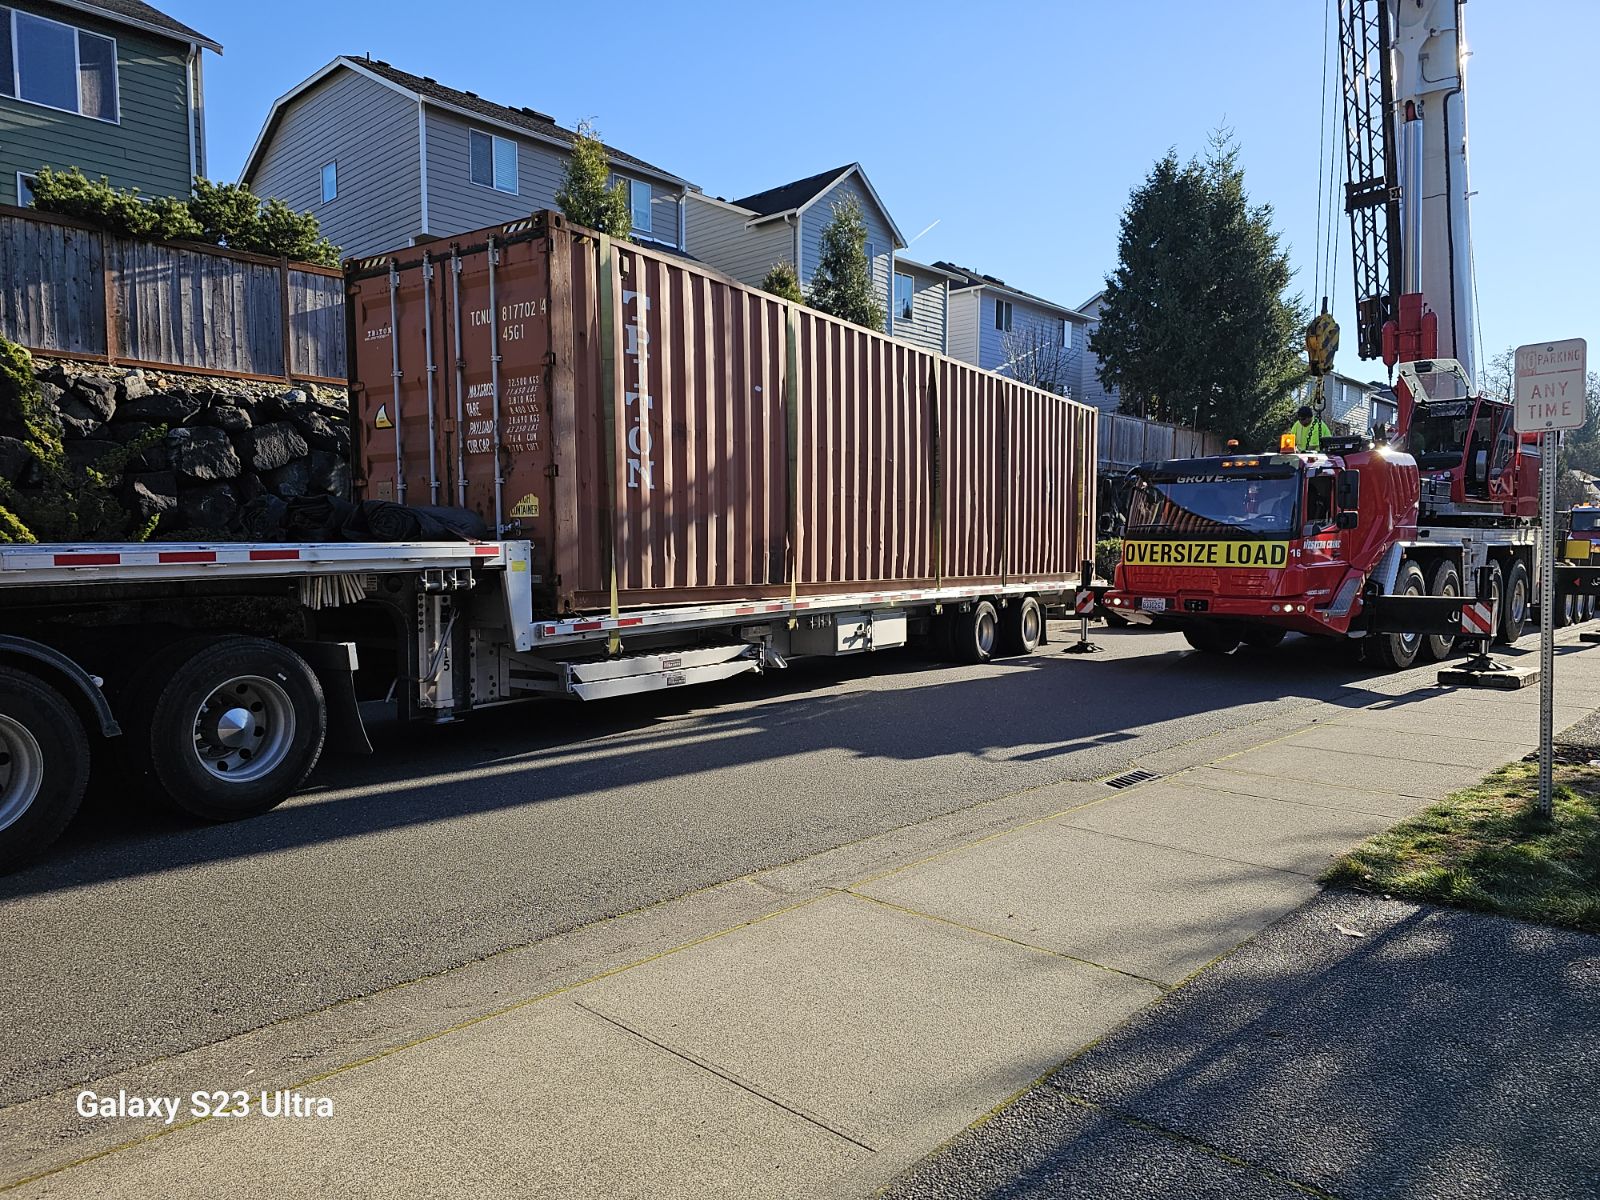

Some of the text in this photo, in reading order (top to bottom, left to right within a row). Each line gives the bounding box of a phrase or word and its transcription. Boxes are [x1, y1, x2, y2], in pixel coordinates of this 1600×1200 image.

[470, 309, 491, 326] TCNU
[502, 301, 536, 321] 817702
[503, 324, 524, 341] 45G1
[1537, 350, 1580, 366] PARKING
[623, 289, 655, 489] TRITON
[1531, 381, 1568, 399] ANY
[466, 402, 482, 417] TARE
[1528, 401, 1572, 419] TIME
[468, 420, 494, 435] PAYLOAD
[1125, 543, 1286, 566] OVERSIZE LOAD
